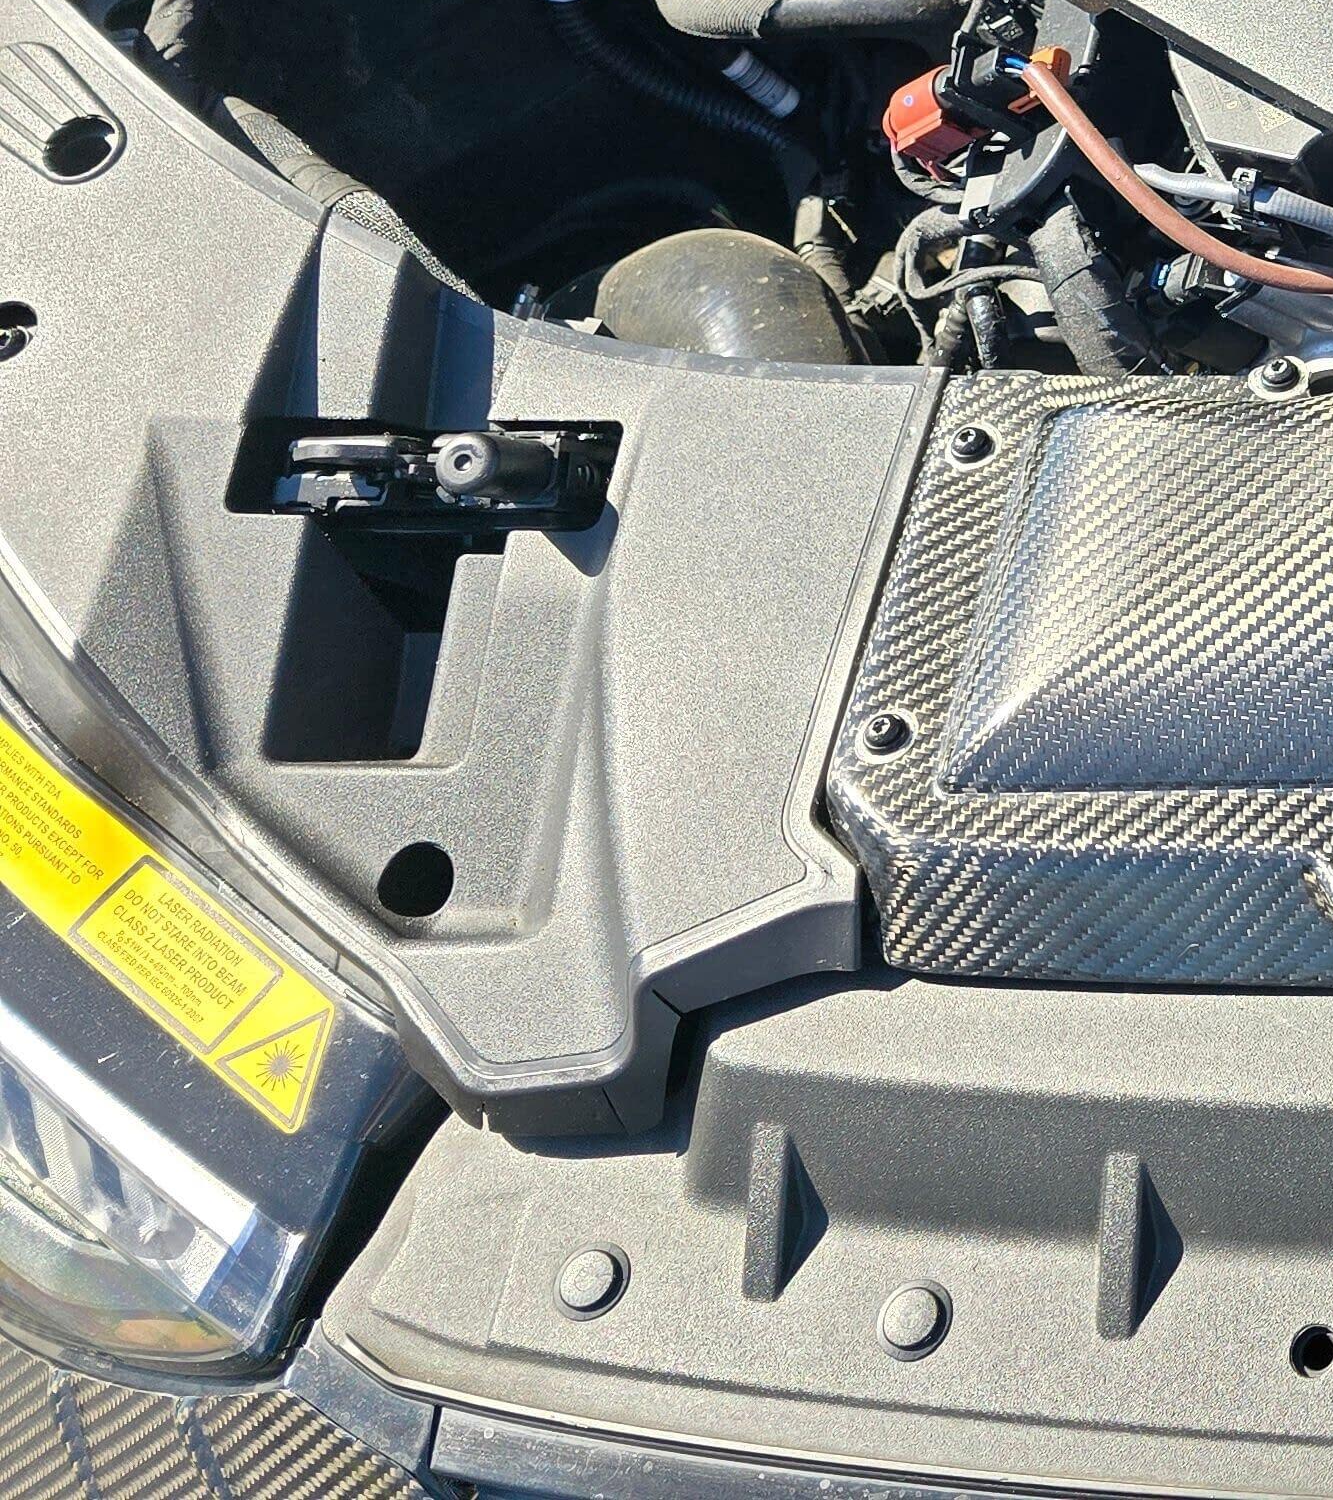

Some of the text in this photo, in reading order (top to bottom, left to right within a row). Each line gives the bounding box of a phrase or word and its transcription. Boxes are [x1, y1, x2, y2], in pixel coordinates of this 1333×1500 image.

[21, 761, 46, 784] WITH
[41, 779, 63, 801] FDA
[28, 790, 83, 840] STANDARDS
[3, 790, 51, 835] PRODUCTS
[46, 829, 84, 864] EXCEPT
[81, 858, 104, 881] FOR
[20, 830, 70, 875] PURSUANT
[65, 869, 82, 886] TO
[111, 903, 235, 1012] CLASS 2 LASER PRODUCT
[123, 887, 248, 997] DO NOT STARE INTO BEAM
[156, 890, 245, 968] LASER RADIATION
